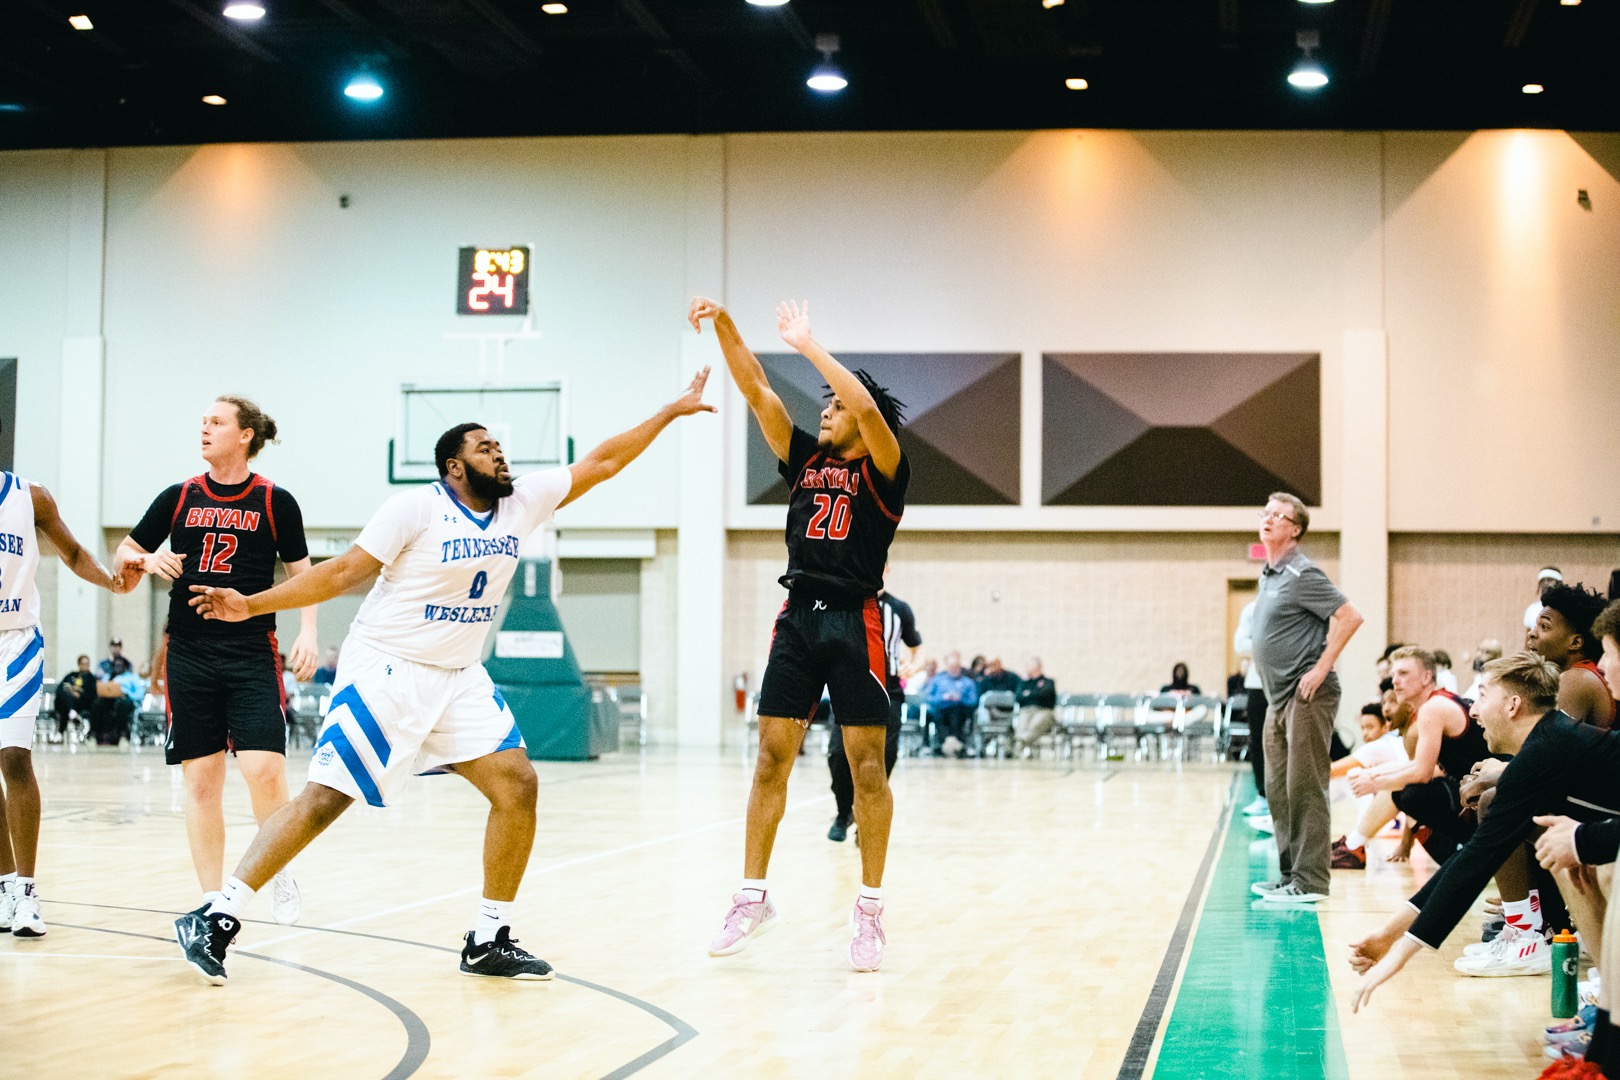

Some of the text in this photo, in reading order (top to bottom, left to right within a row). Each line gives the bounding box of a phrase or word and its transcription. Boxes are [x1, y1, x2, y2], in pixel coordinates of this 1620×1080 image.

[468, 272, 514, 310] 24
[801, 467, 859, 495] BRYAN
[185, 507, 260, 531] BRYAN
[805, 493, 852, 540] 20
[198, 532, 238, 573] 12
[468, 570, 487, 599] 0
